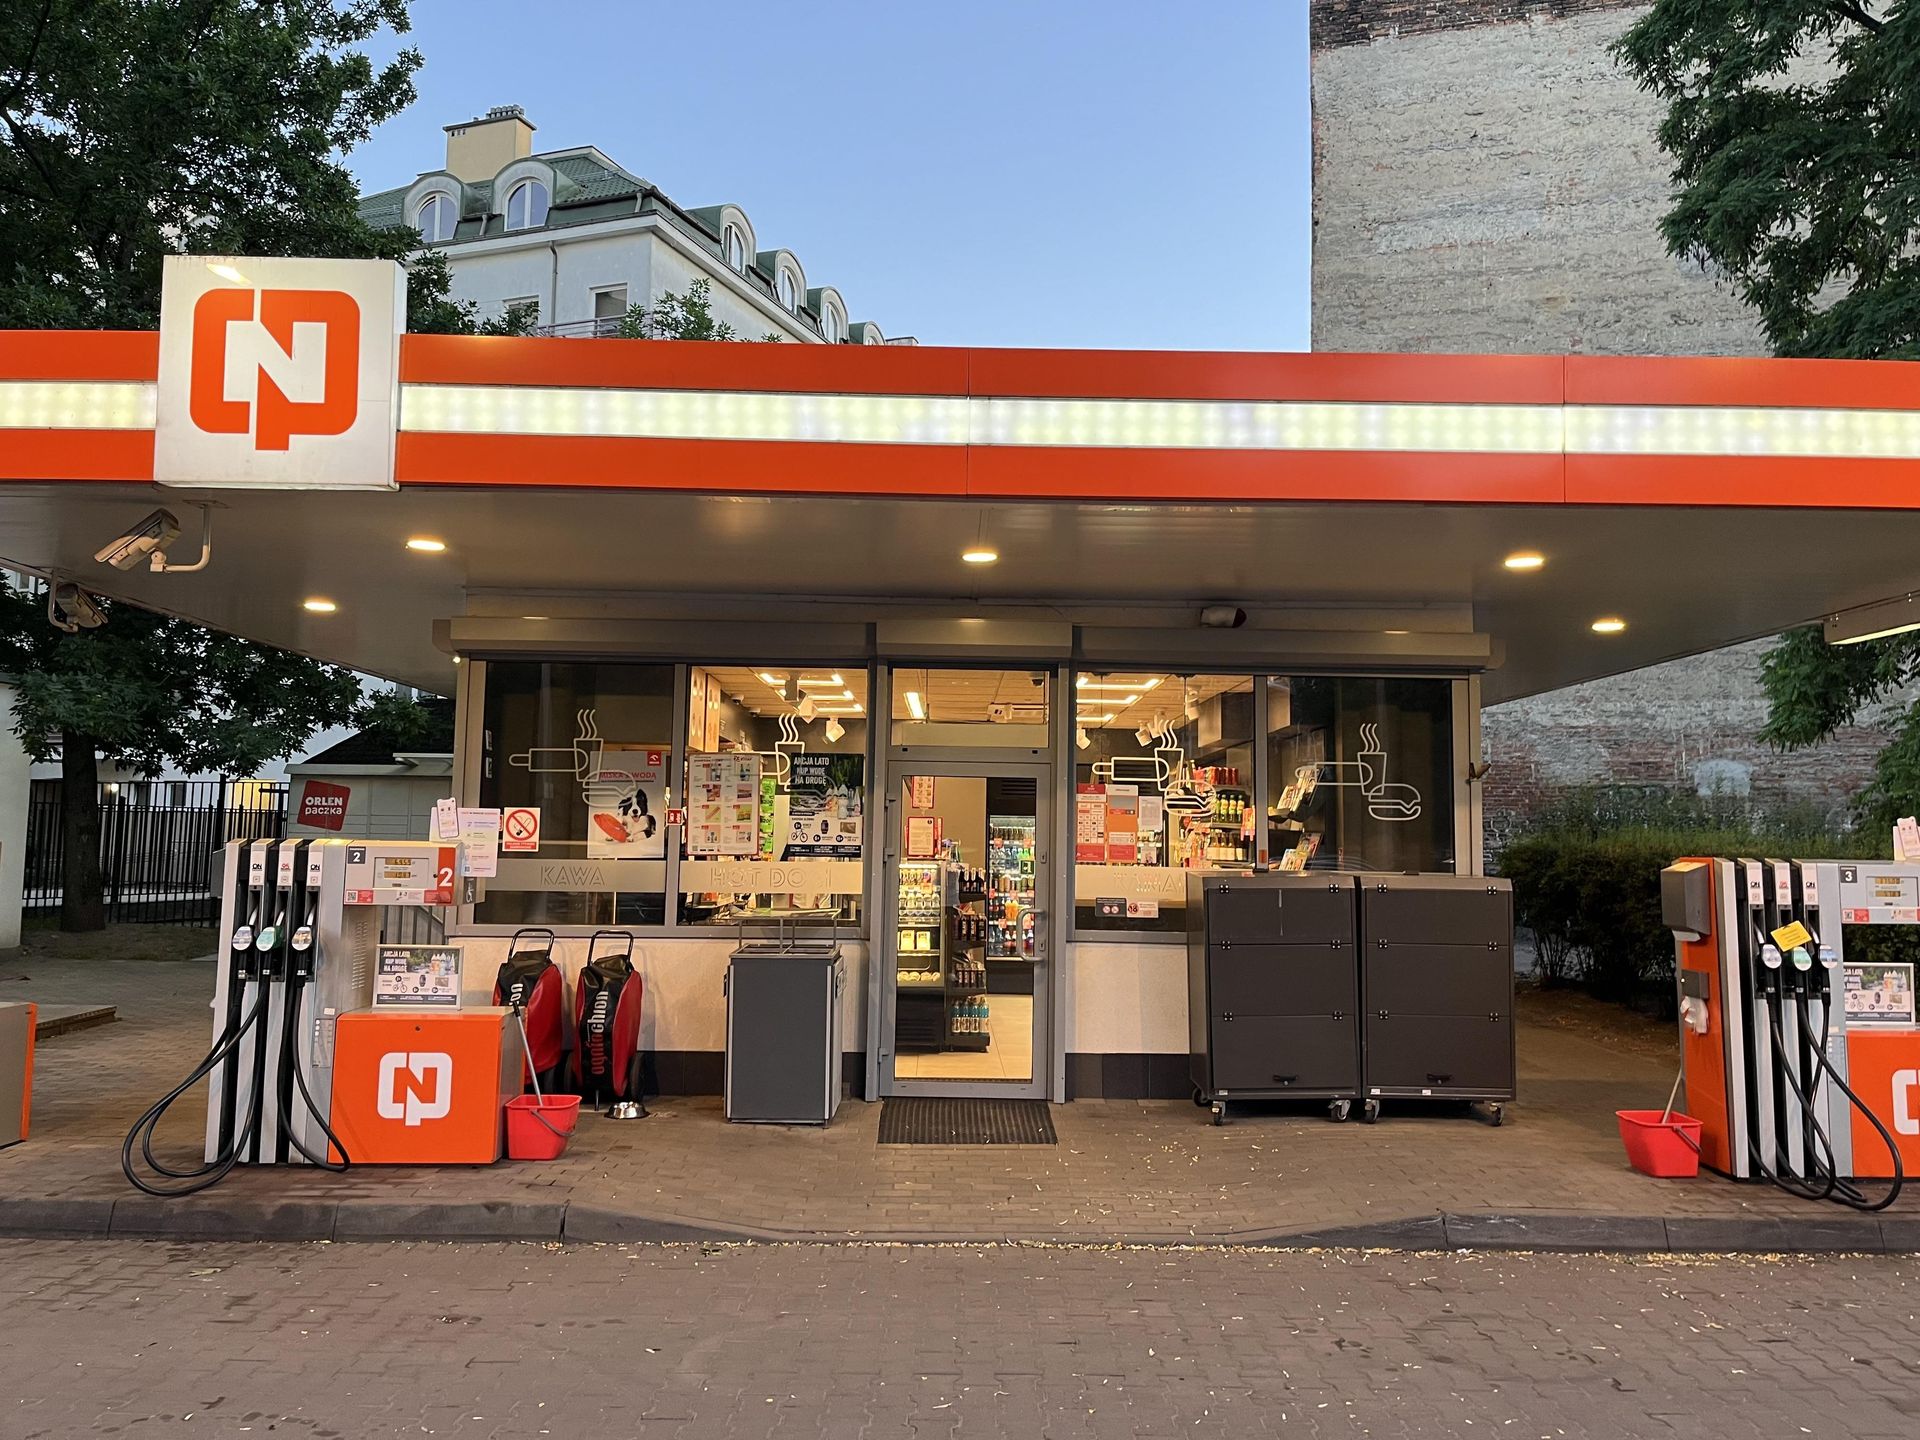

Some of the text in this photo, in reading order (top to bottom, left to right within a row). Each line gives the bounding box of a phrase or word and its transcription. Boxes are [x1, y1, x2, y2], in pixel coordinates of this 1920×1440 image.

[814, 756, 830, 766] LATO
[305, 796, 343, 806] ORLEN
[305, 807, 343, 816] paczka
[353, 852, 361, 862] 2
[439, 867, 453, 887] 2
[540, 866, 605, 886] KAWA
[711, 867, 762, 888] HOT
[1845, 871, 1853, 882] 3
